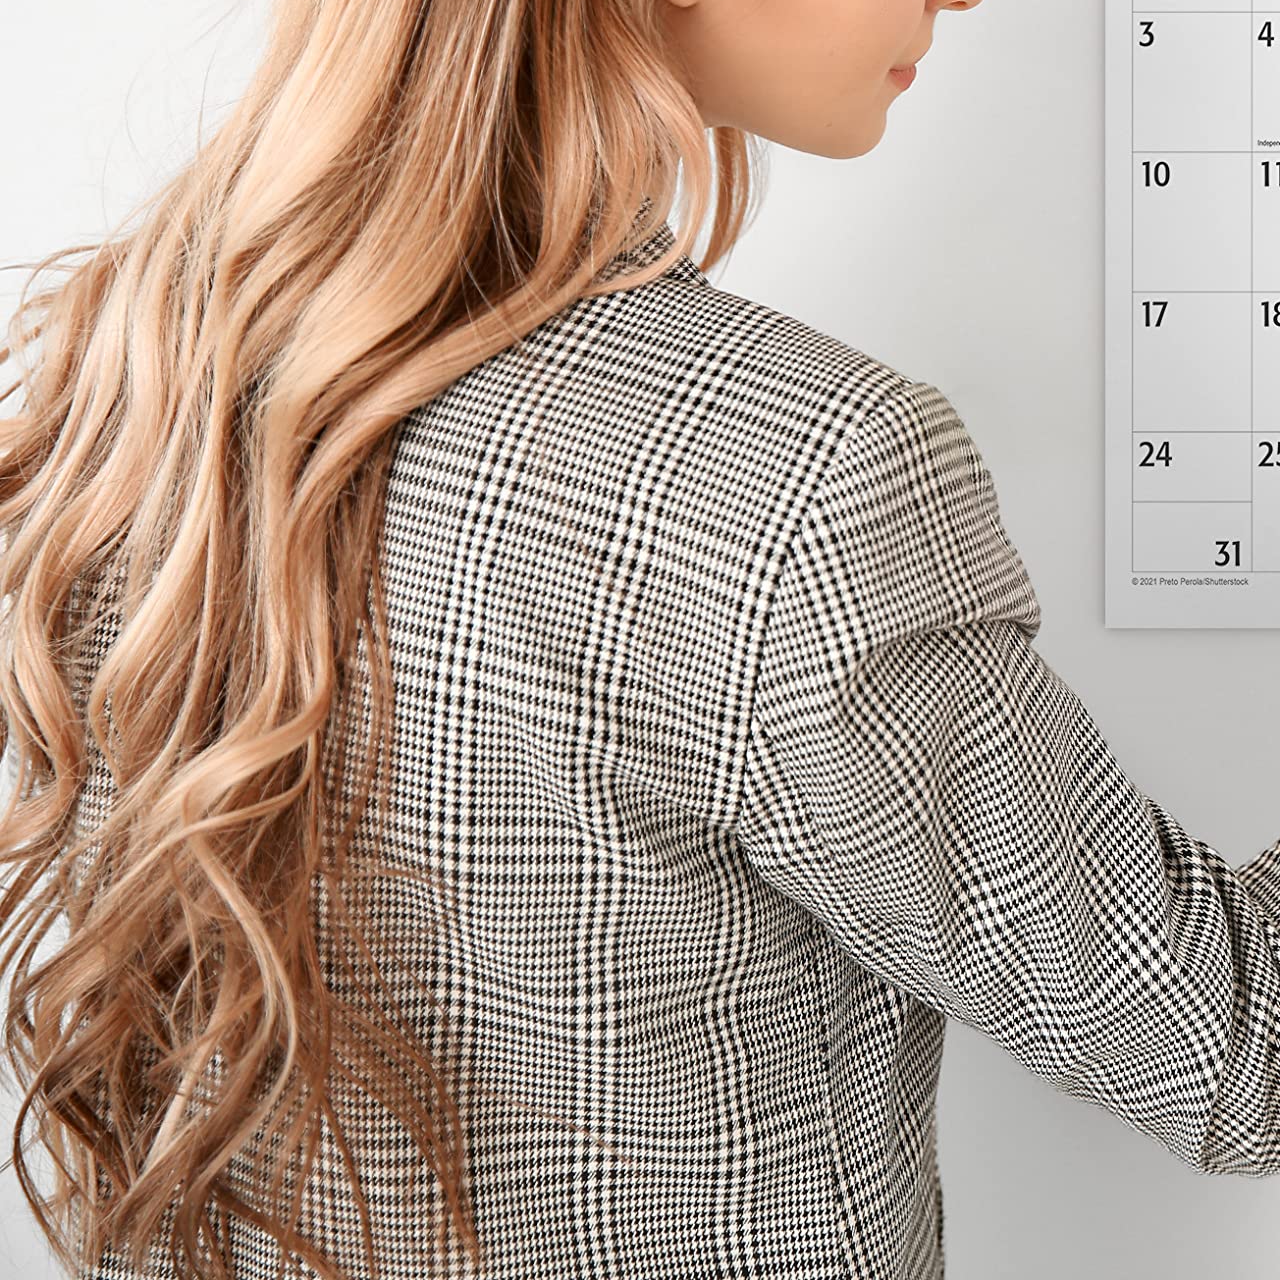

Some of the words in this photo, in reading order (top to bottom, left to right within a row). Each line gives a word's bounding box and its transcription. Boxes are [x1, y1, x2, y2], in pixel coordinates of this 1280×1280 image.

[1139, 22, 1154, 46] 3
[1258, 22, 1274, 47] 4
[1142, 161, 1170, 187] 10
[1142, 301, 1168, 327] 17
[1139, 442, 1172, 467] 24
[1215, 541, 1240, 566] 31
[1139, 577, 1157, 586] 2021
[1159, 577, 1179, 586] Preto
